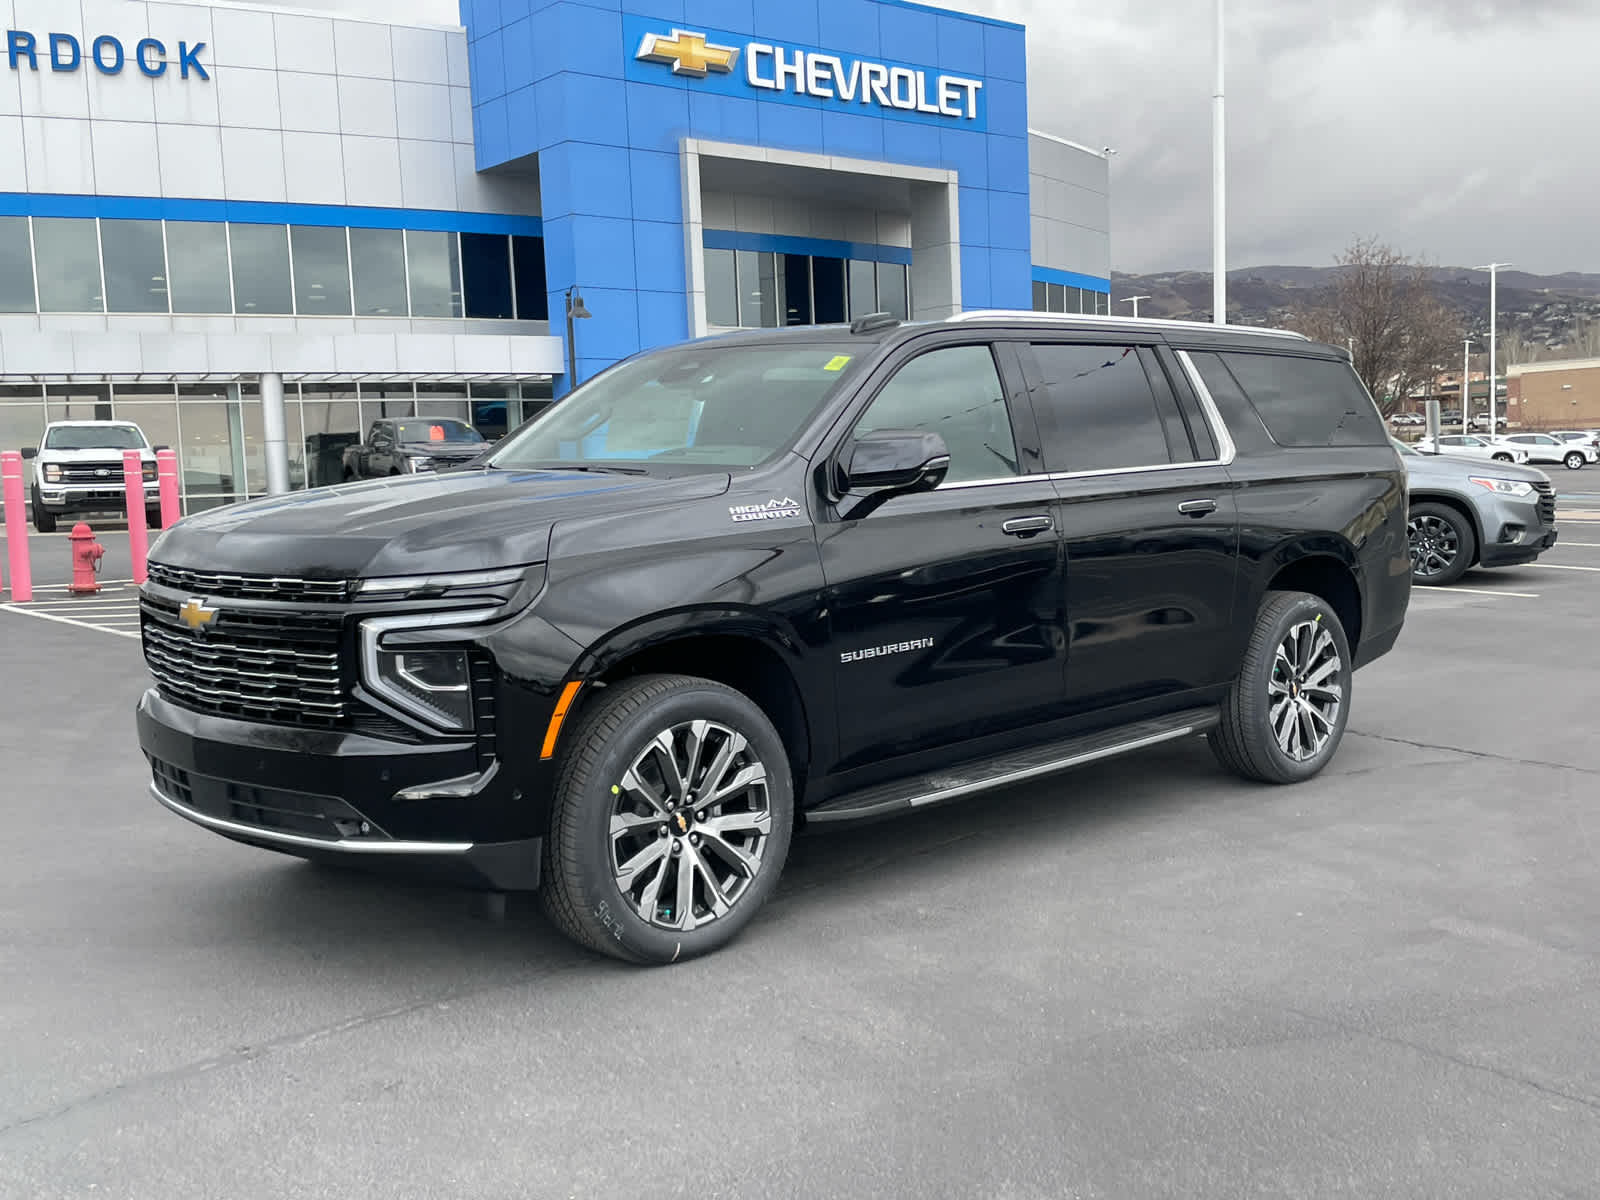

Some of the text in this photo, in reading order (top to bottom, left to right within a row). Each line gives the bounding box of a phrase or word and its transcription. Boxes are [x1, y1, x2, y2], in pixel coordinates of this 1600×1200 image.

[7, 29, 210, 81] RDOCK
[746, 42, 983, 119] CHEVROLET
[729, 504, 767, 515] HIGH
[732, 508, 801, 522] COUNTRY
[840, 637, 934, 663] SUBURBAN
